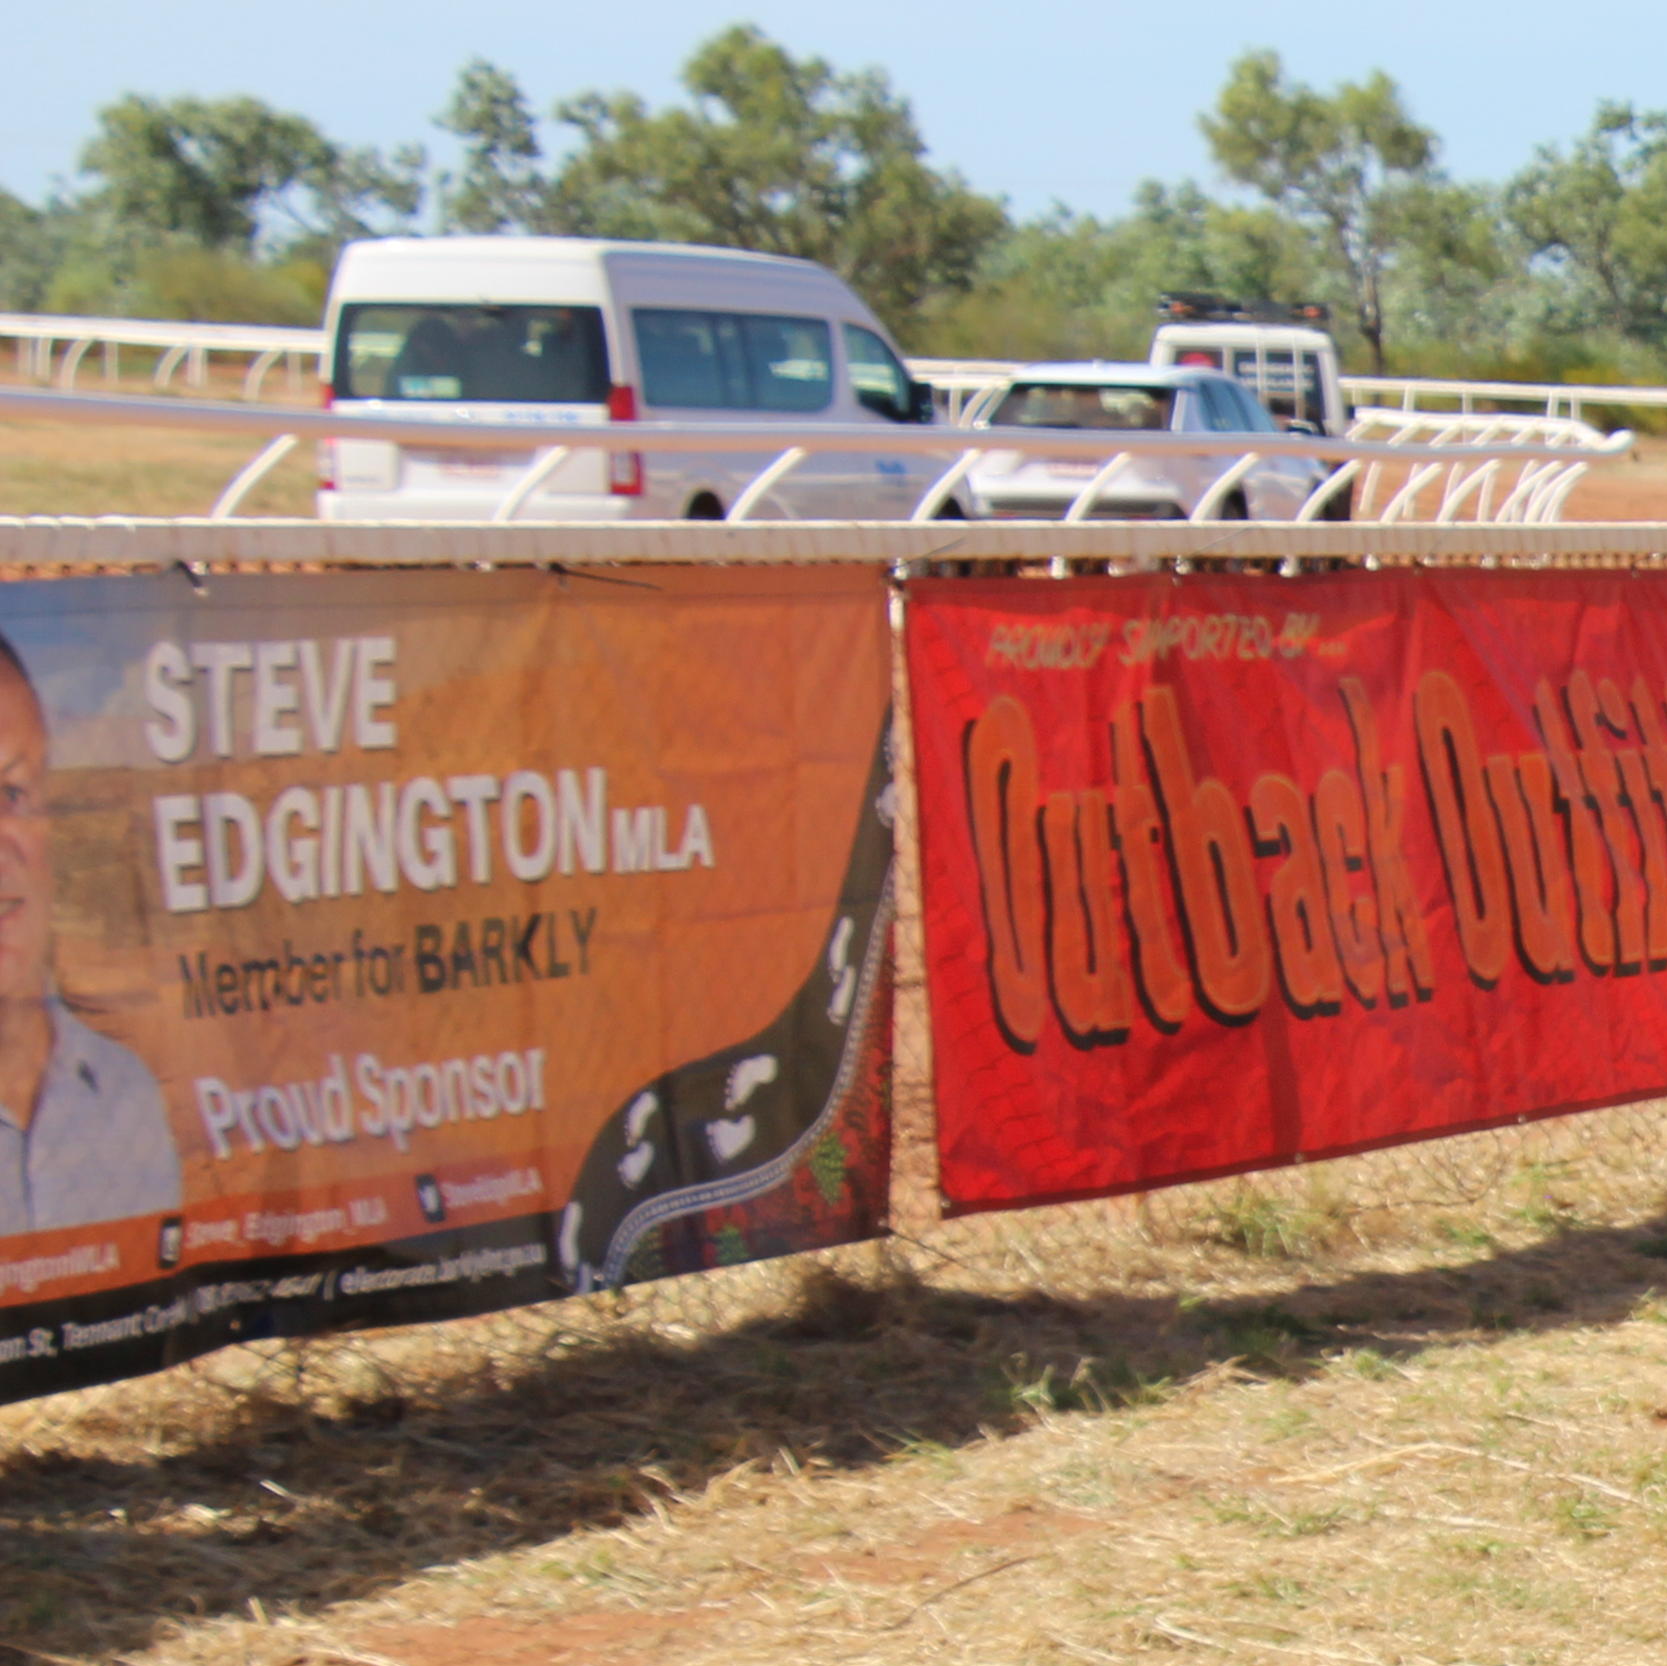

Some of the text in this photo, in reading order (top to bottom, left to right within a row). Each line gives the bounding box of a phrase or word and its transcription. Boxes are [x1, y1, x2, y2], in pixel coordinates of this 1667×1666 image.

[146, 636, 396, 764] STEVE
[985, 622, 1112, 671] PROUDLY
[155, 766, 714, 914] EDGINGTON MLA
[961, 672, 1433, 1055] Outback
[177, 908, 597, 1020] Member for BARKLY
[194, 1047, 547, 1160] Proud Sponsor
